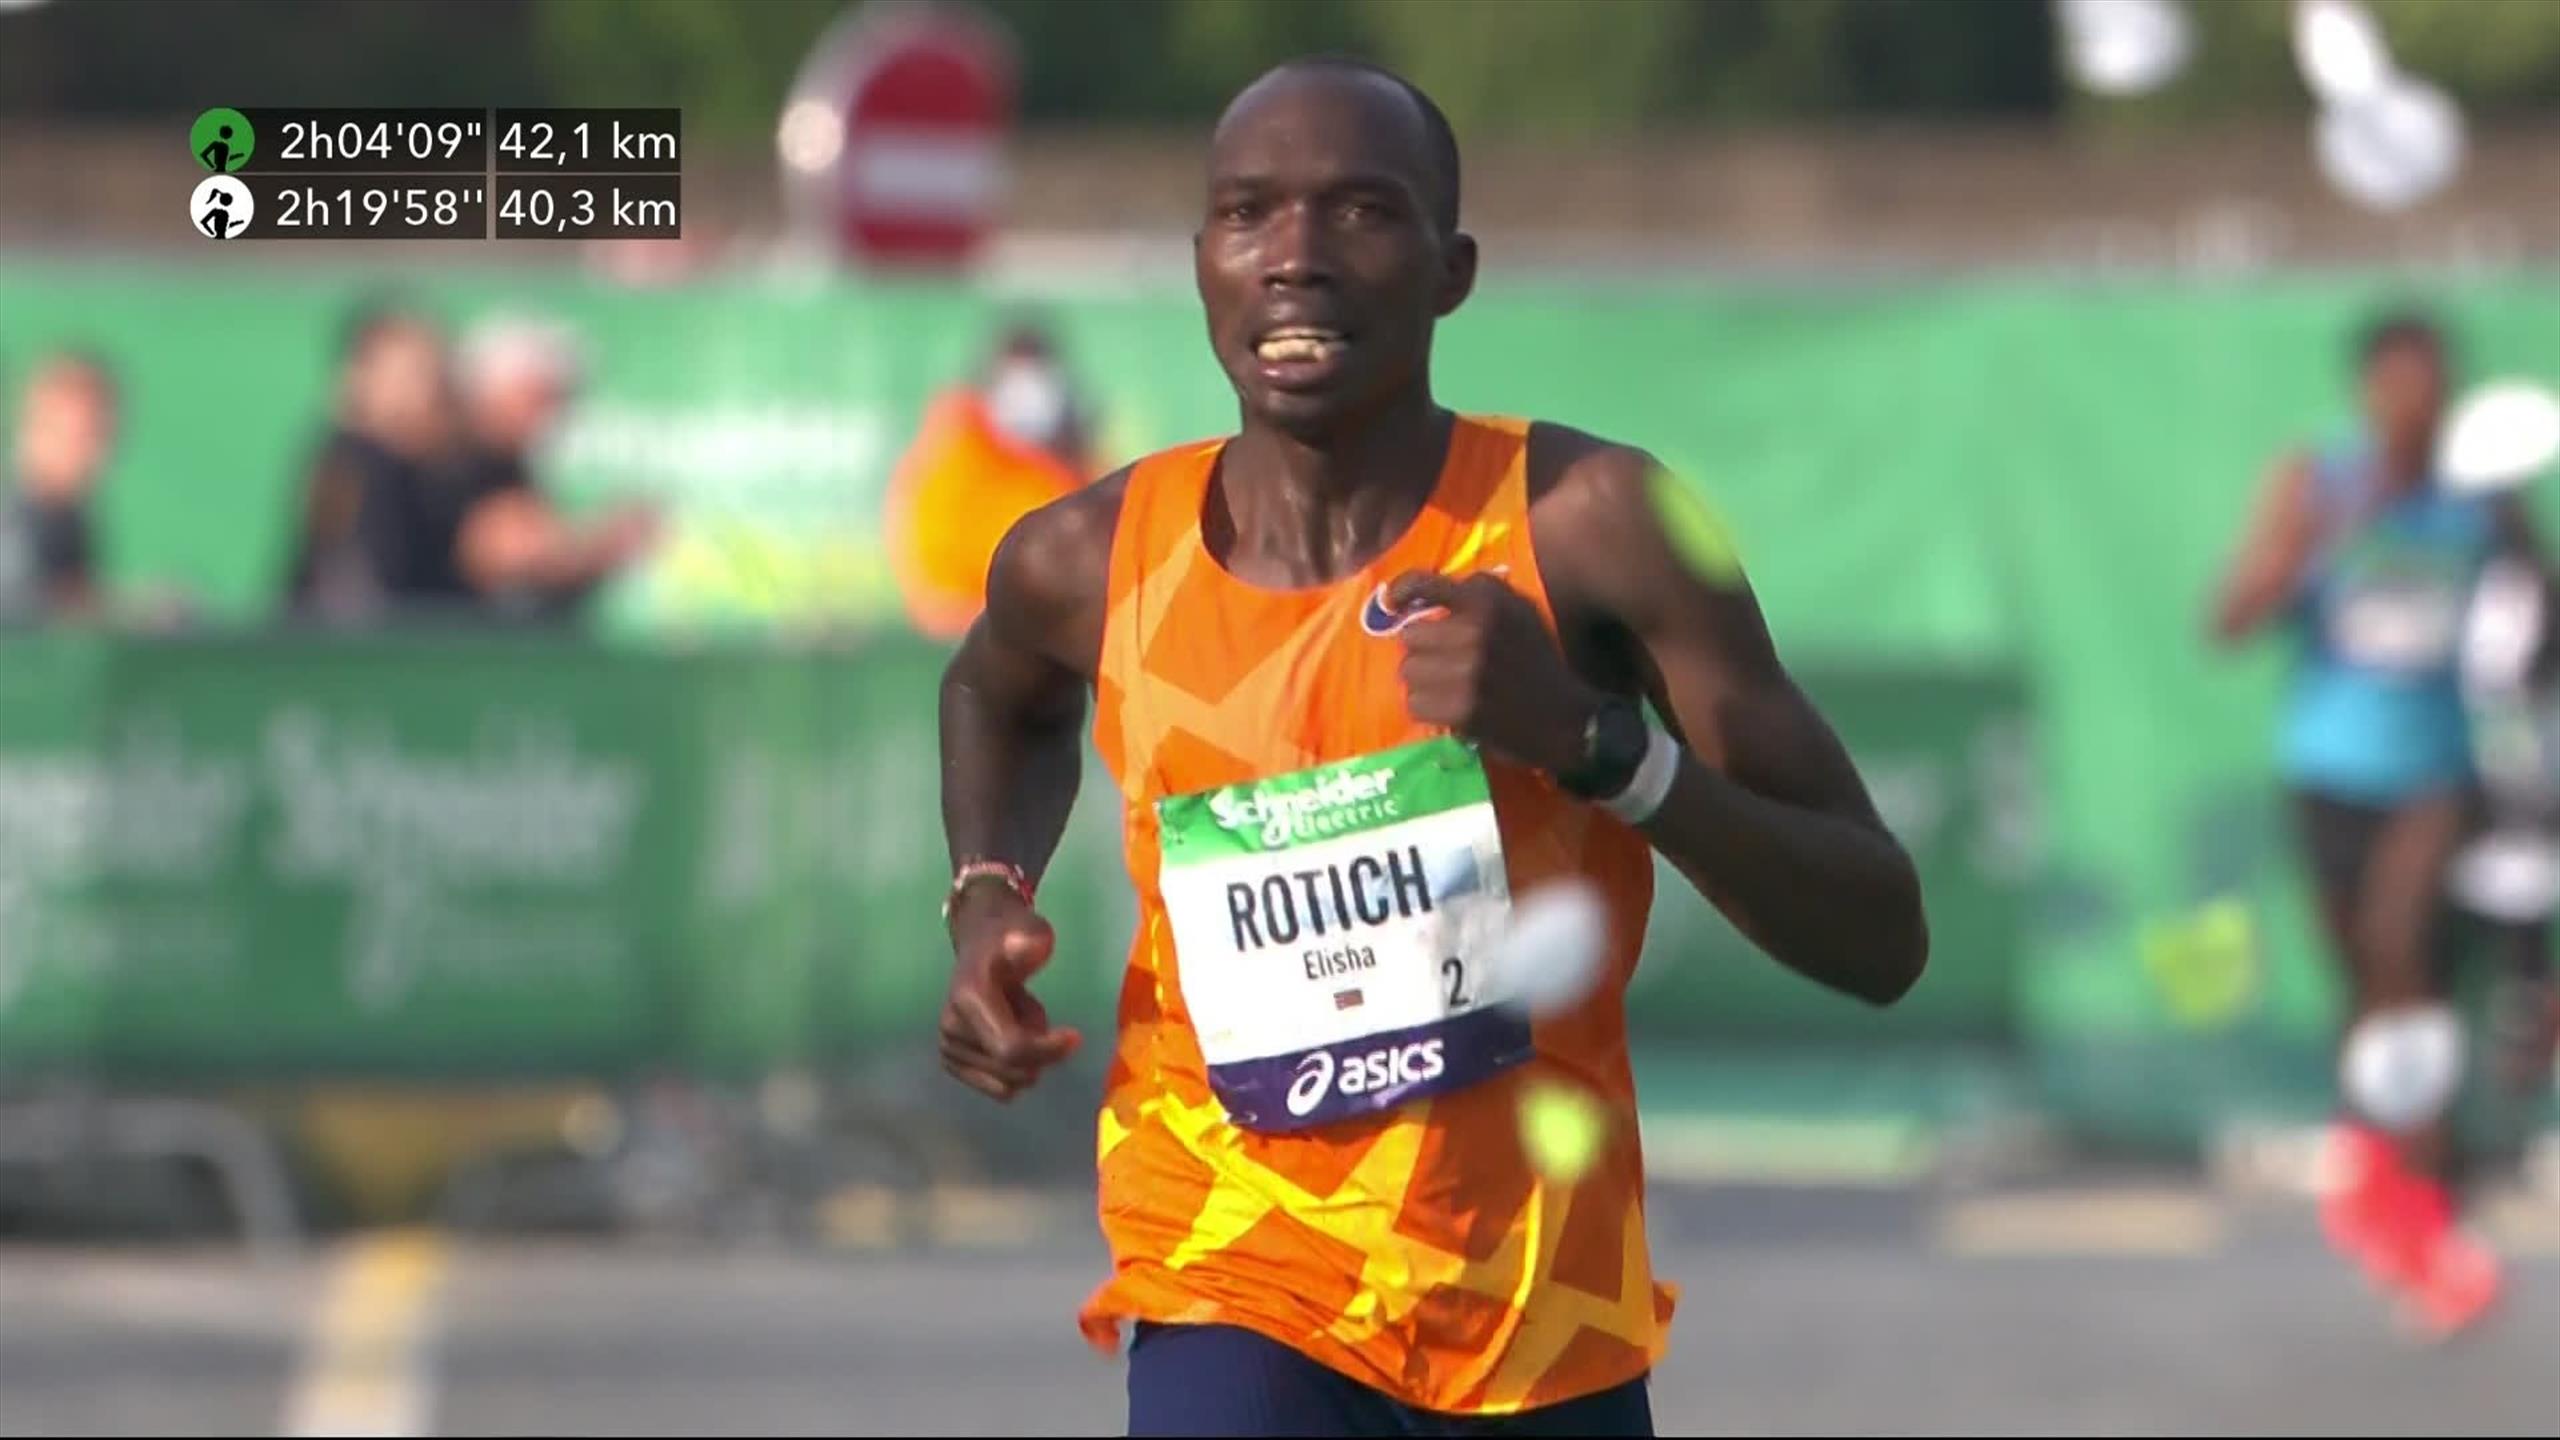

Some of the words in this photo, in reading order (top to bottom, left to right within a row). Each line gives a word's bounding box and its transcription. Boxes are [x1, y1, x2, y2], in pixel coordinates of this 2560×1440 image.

[1209, 768, 1395, 848] Schneider
[1227, 844, 1432, 953] ROTICH
[1302, 943, 1377, 980] Elisha
[1441, 956, 1470, 1008] 2
[1338, 1039, 1445, 1095] asics
